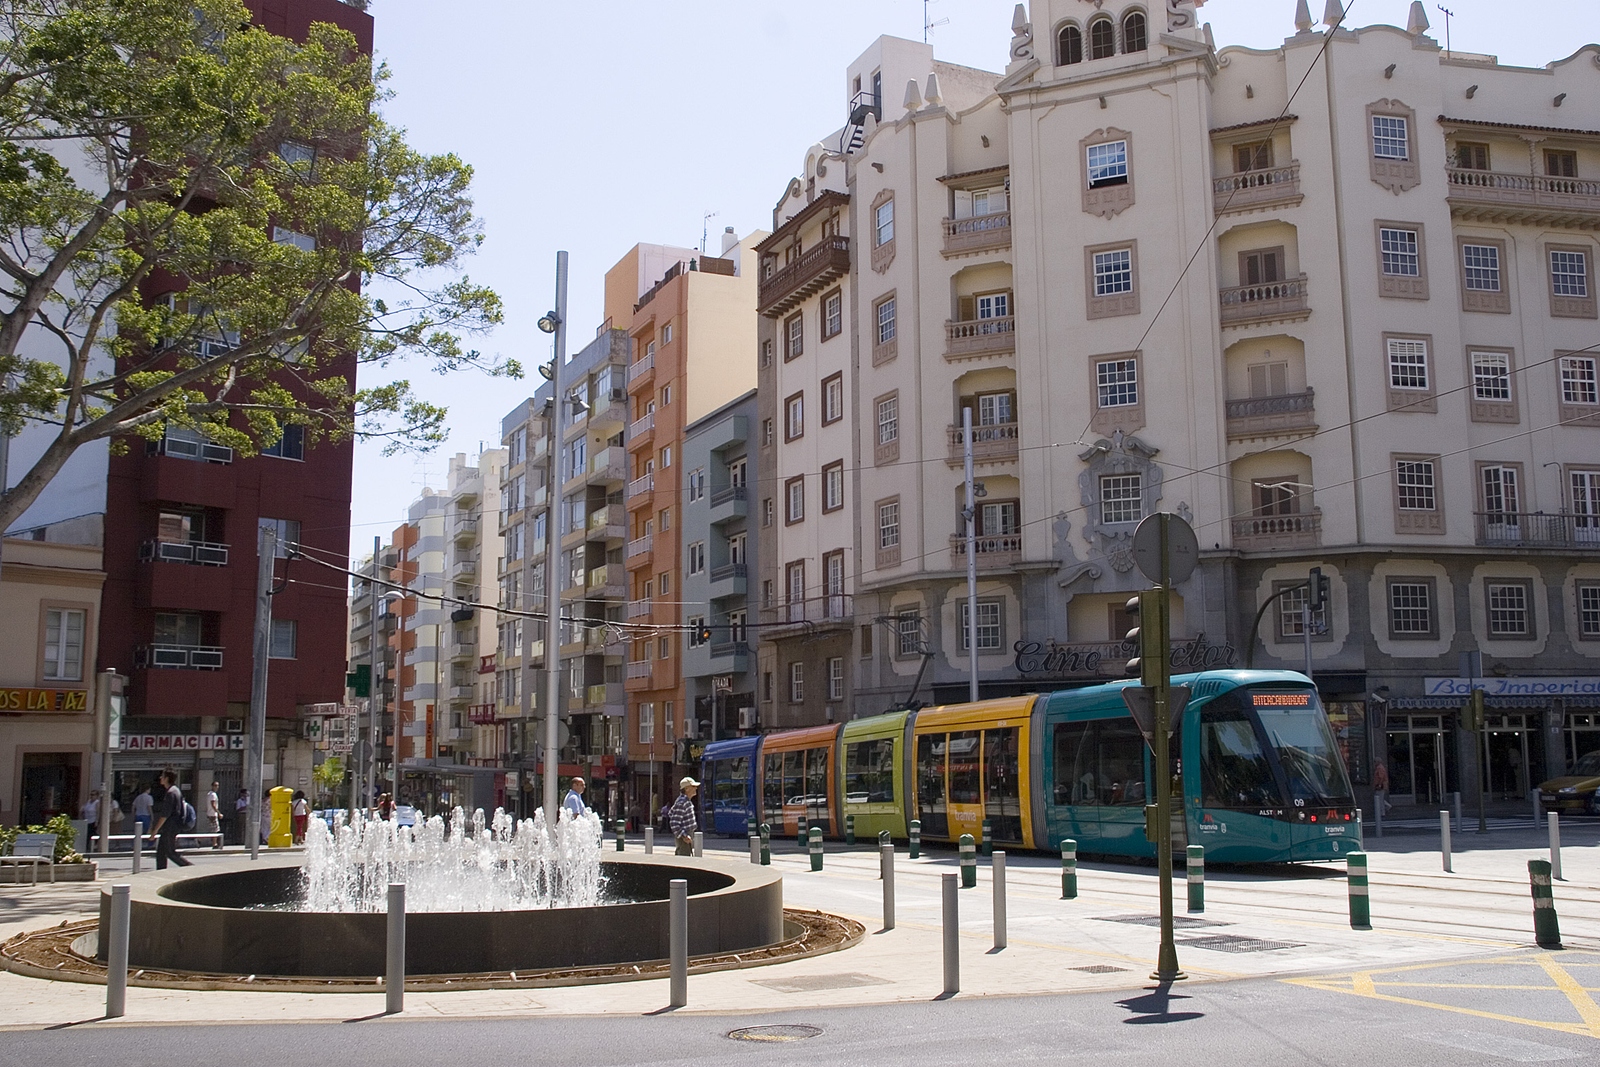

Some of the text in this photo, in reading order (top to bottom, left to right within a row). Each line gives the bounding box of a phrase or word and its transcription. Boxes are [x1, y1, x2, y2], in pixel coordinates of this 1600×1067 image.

[1013, 632, 1239, 673] Cine ctor
[1430, 678, 1485, 694] Bar
[27, 691, 49, 710] LA
[1294, 798, 1305, 807] 09
